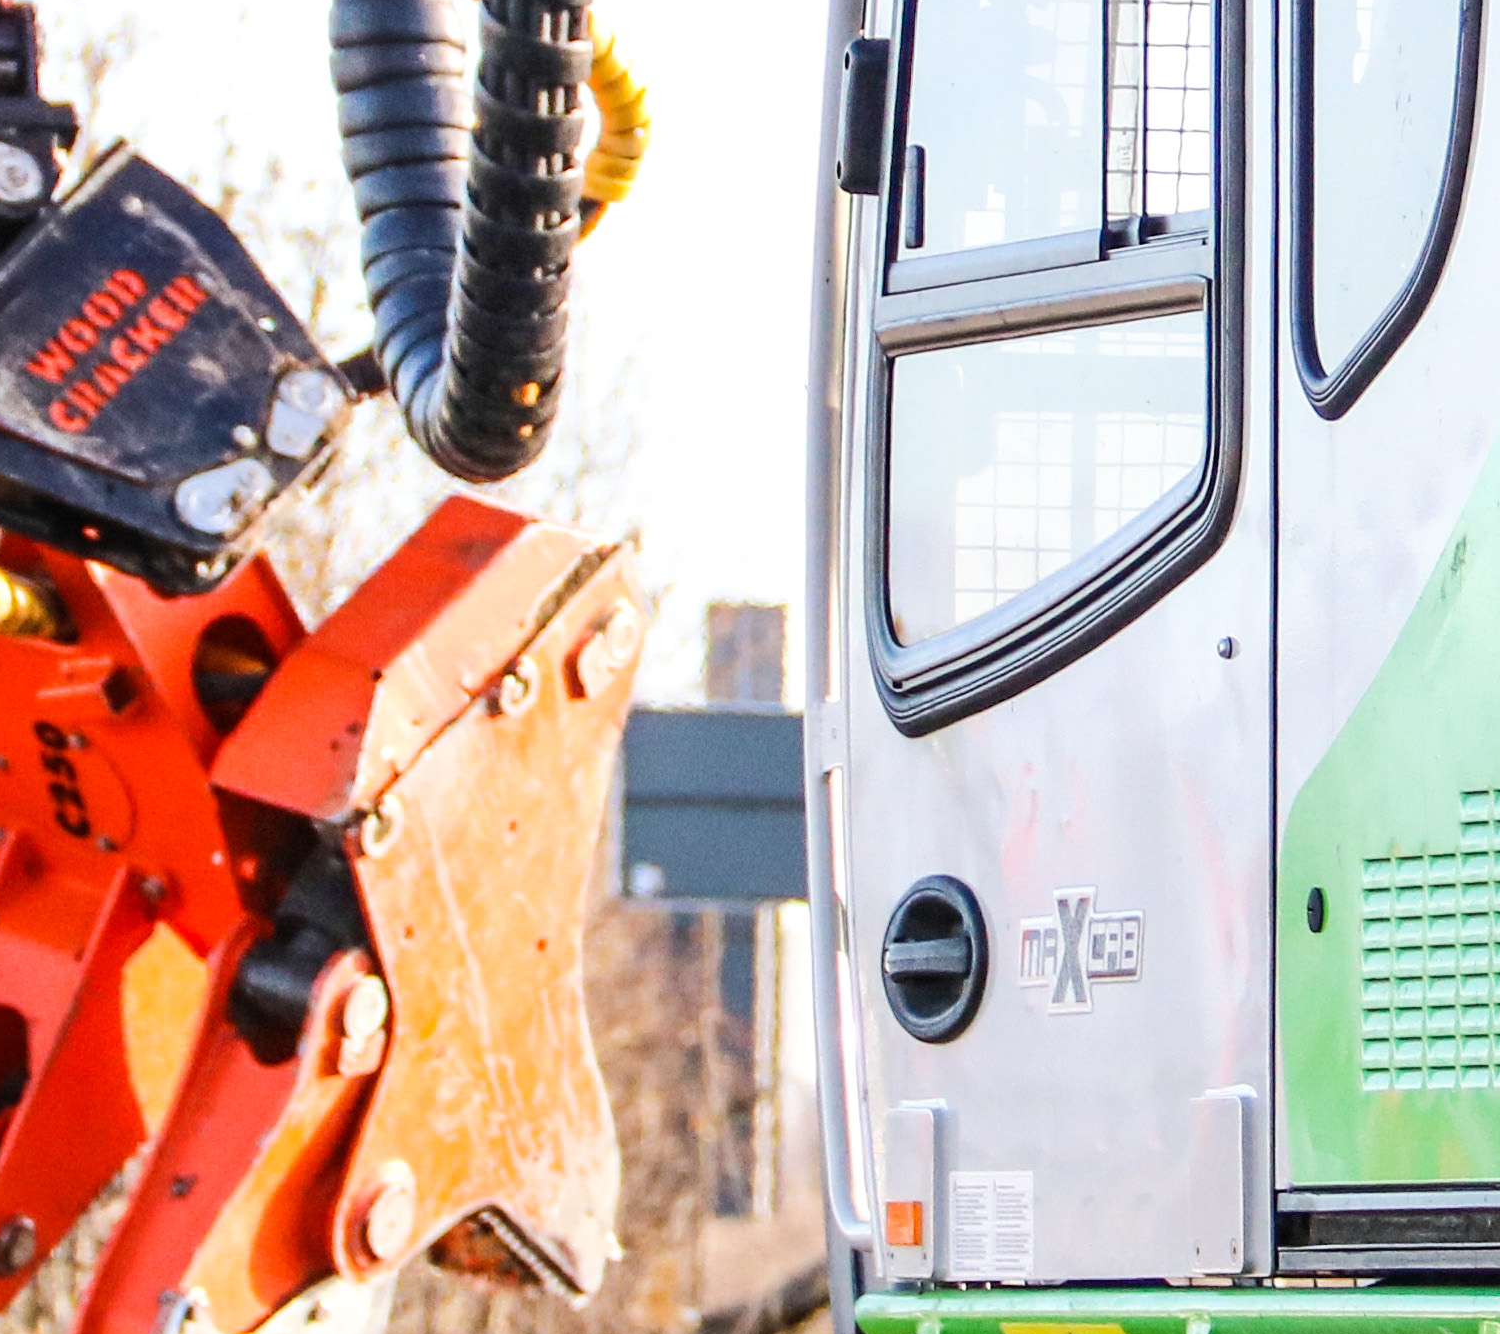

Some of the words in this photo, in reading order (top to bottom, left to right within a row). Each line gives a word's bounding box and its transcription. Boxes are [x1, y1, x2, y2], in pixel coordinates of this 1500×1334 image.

[27, 266, 148, 385] WOOD
[50, 273, 209, 438] CRACKER
[35, 722, 93, 839] C250
